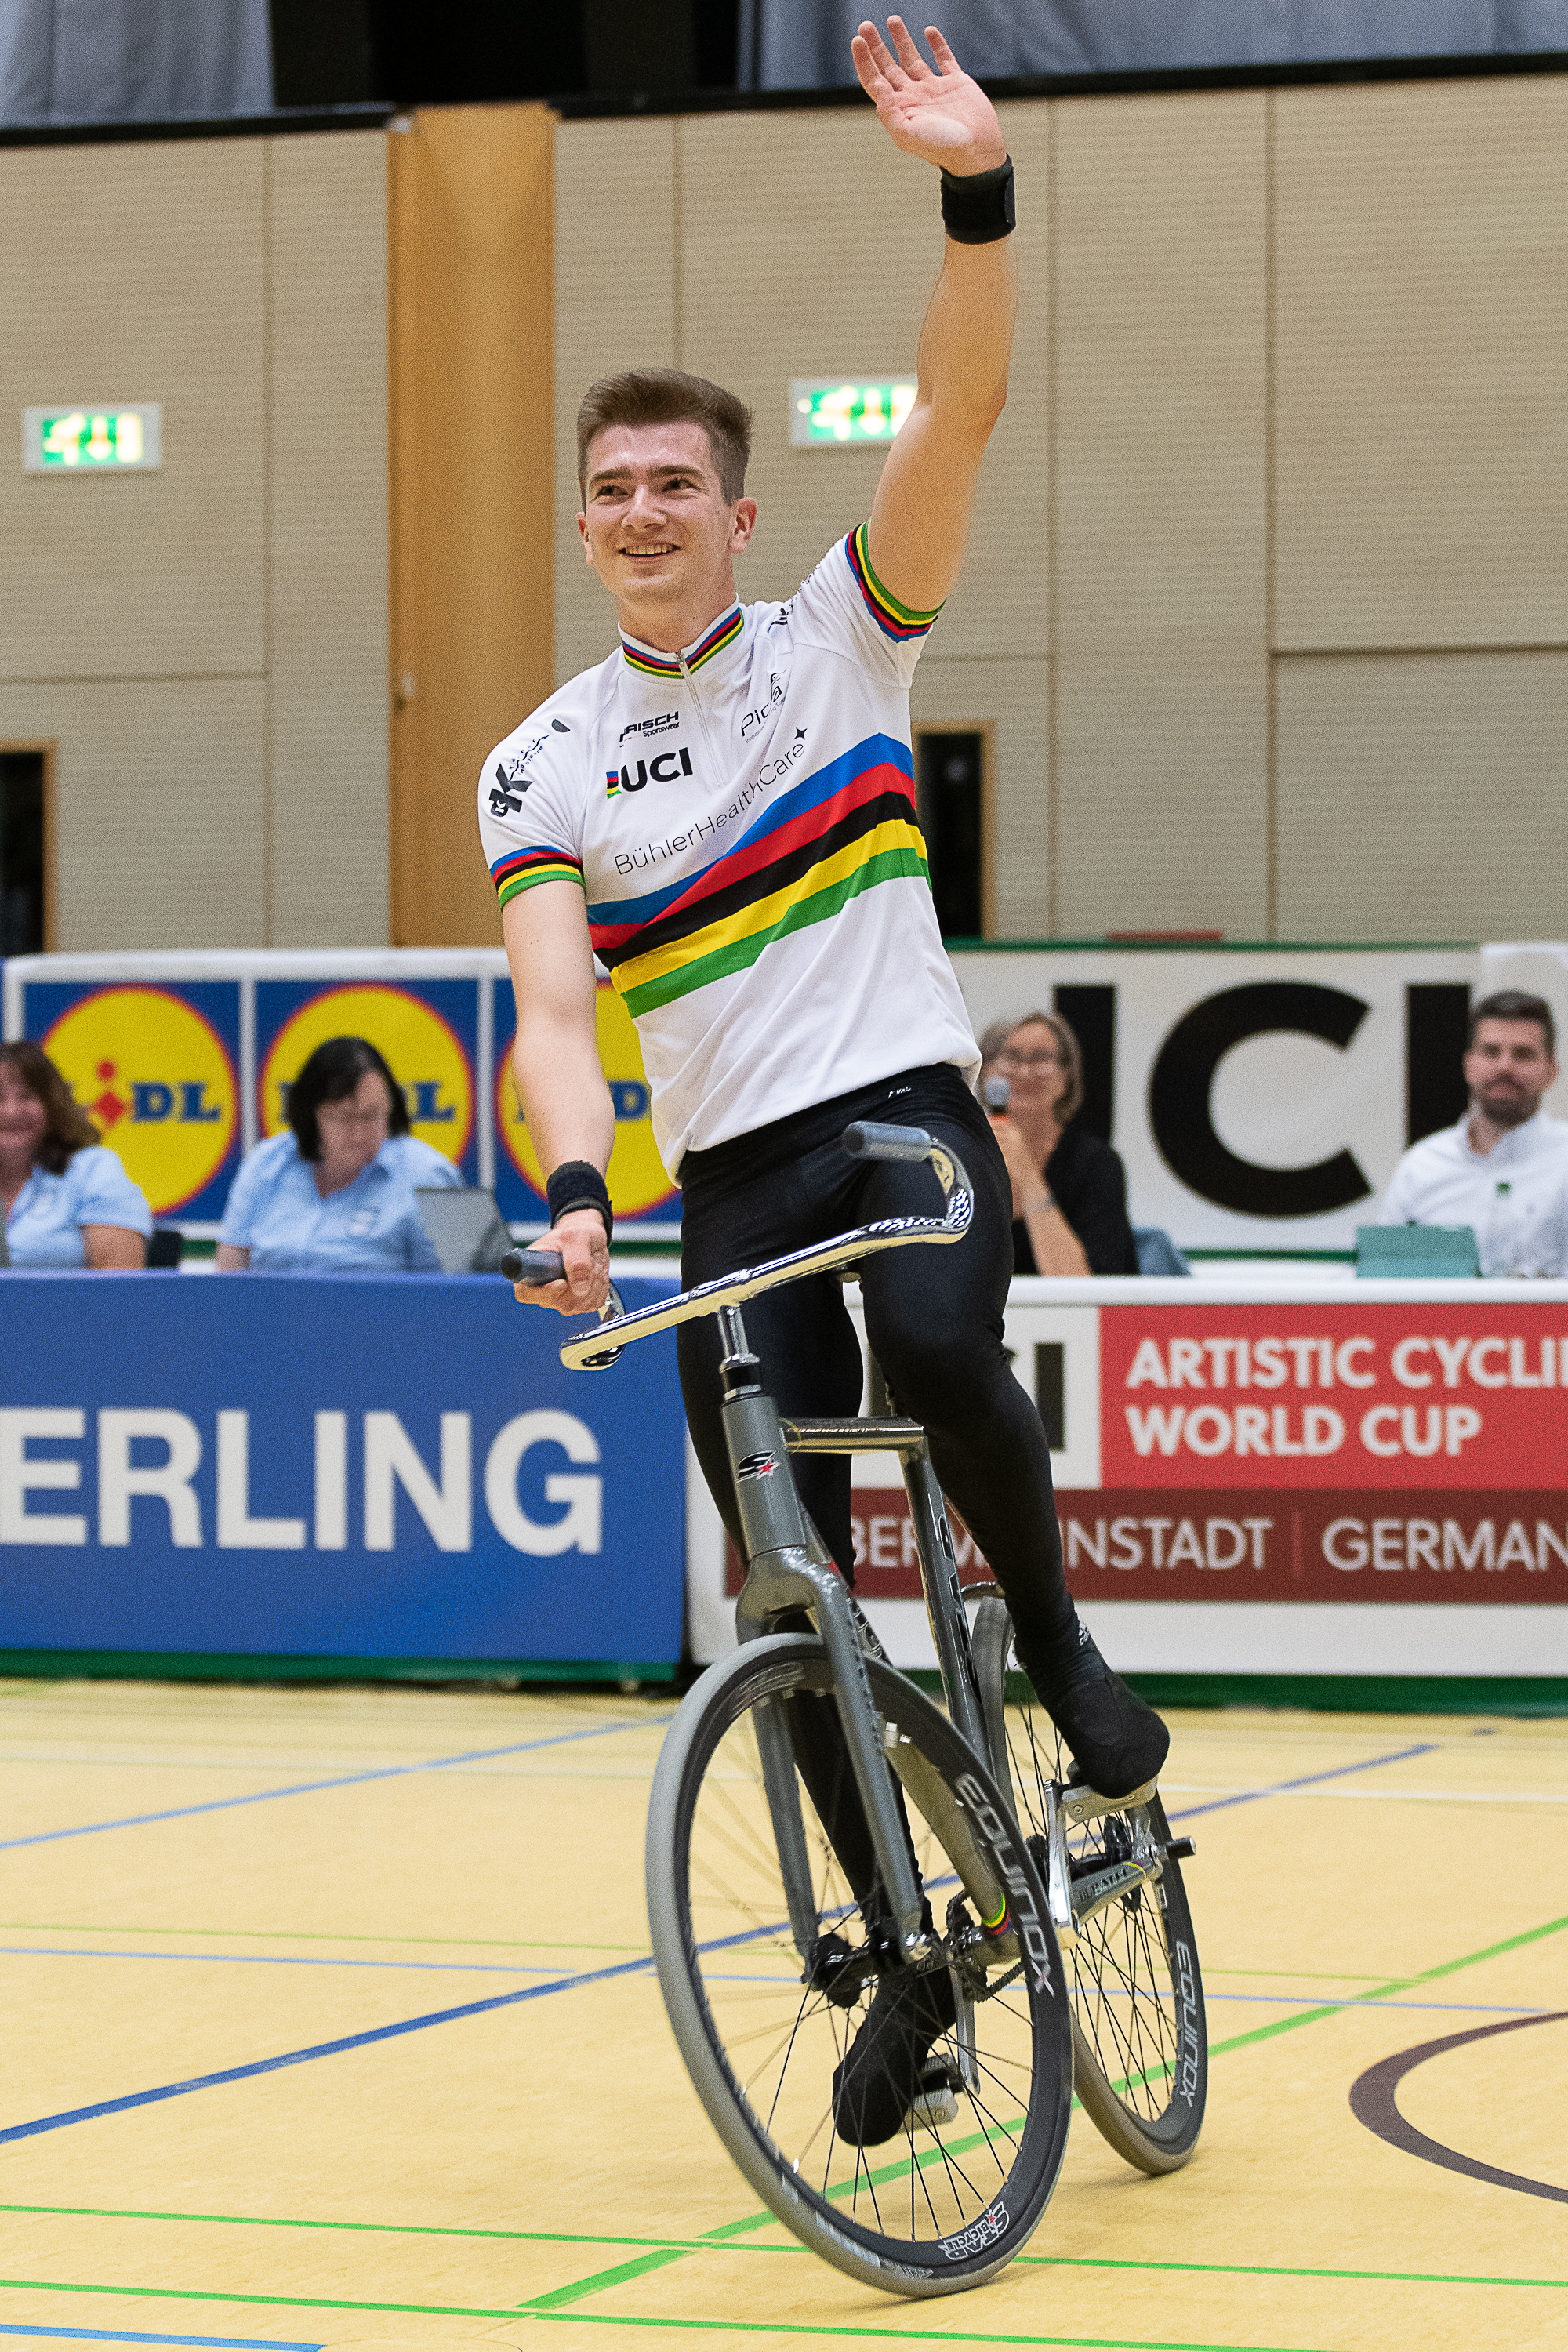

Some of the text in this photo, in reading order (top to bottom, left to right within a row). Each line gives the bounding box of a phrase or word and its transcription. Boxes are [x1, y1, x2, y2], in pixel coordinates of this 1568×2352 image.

[620, 747, 693, 792] UCI
[643, 722, 680, 738] Sportswear
[614, 743, 804, 875] BühlerHealthCare
[1053, 982, 1471, 1221] CI
[1125, 1338, 1376, 1388] ARTISTIC
[1125, 1405, 1482, 1457] WORLD CUP
[0, 1408, 602, 1555] ERLING
[1321, 1518, 1568, 1570] GERMAN
[955, 1772, 1055, 1998] EQUINOX
[1176, 1941, 1198, 2107] EQUINOX
